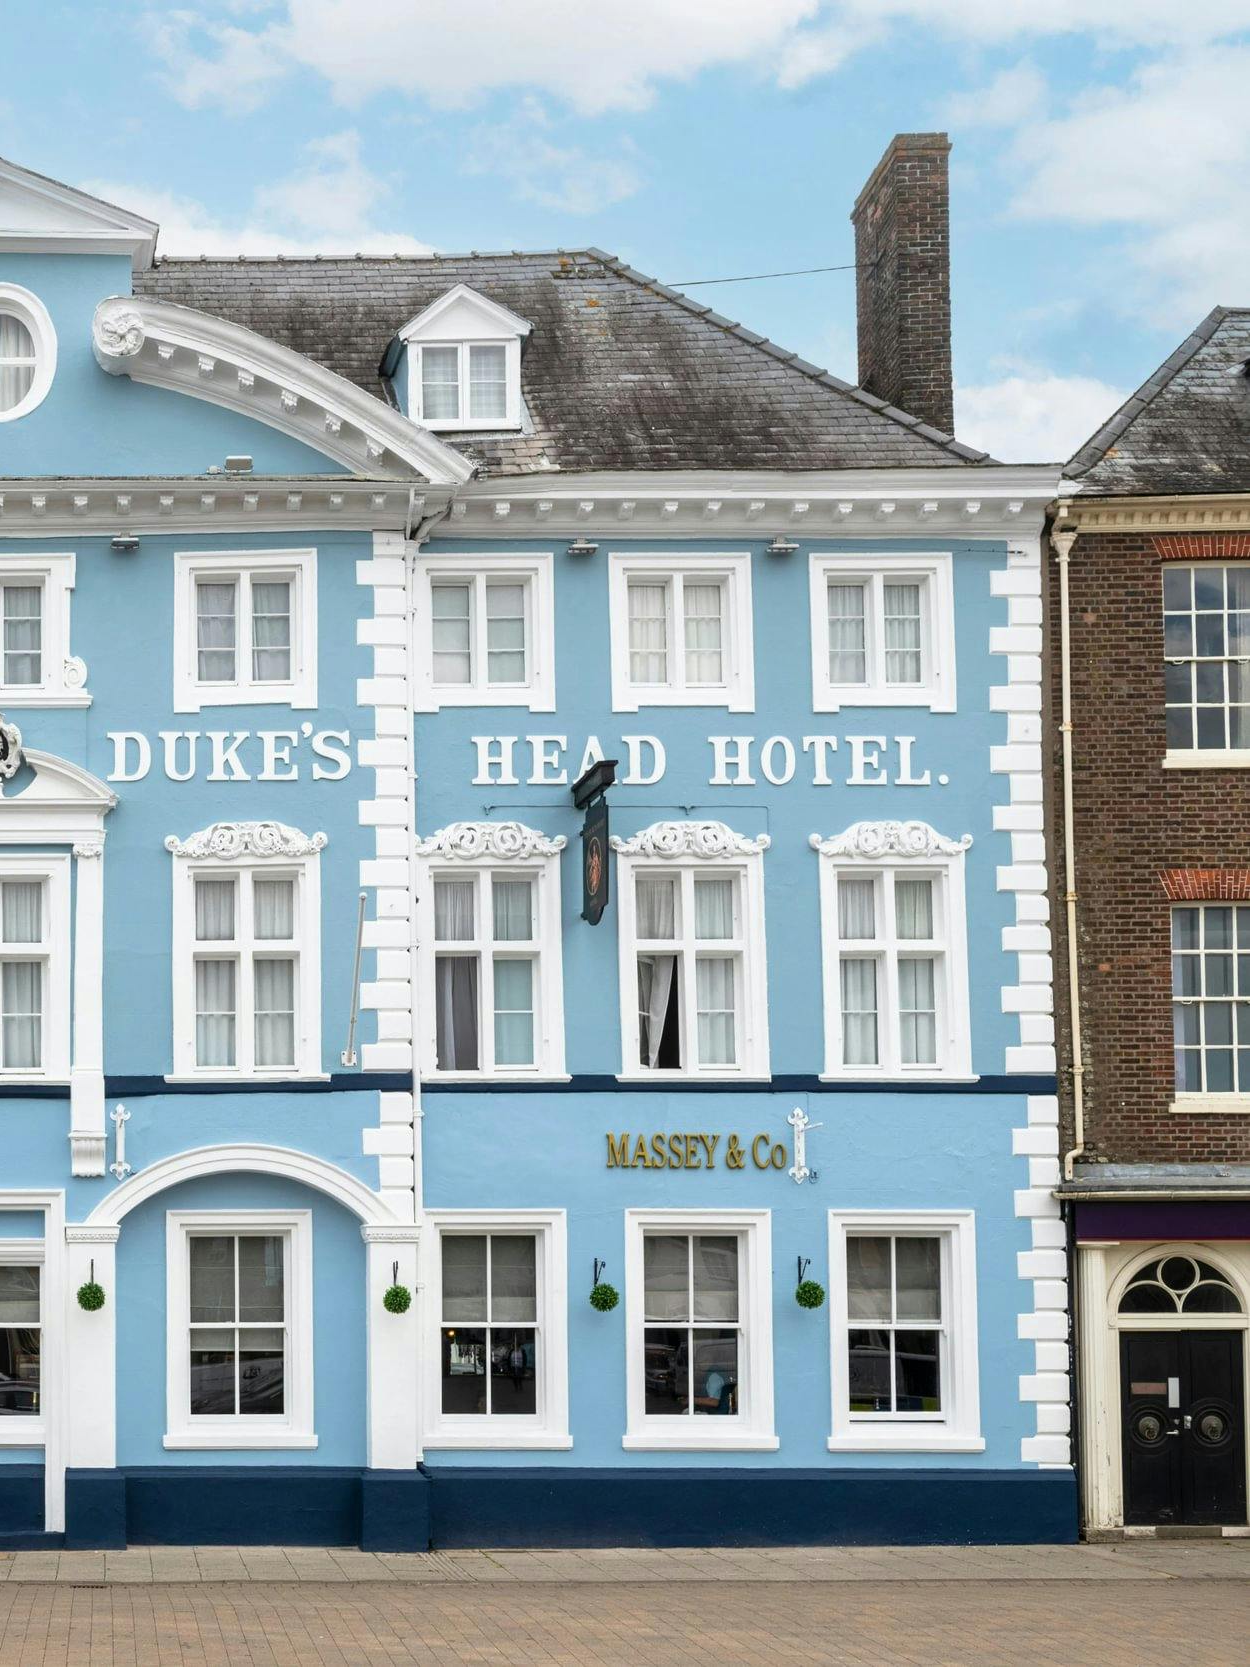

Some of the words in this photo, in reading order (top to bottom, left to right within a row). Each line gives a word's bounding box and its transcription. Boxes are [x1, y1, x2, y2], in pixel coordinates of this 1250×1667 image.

[106, 721, 352, 782] DUKE'S
[471, 735, 667, 786] HEAD
[707, 735, 949, 786] HOTEL.
[606, 1132, 720, 1169] MASSEY
[725, 1133, 745, 1169] &
[752, 1133, 787, 1169] Co
